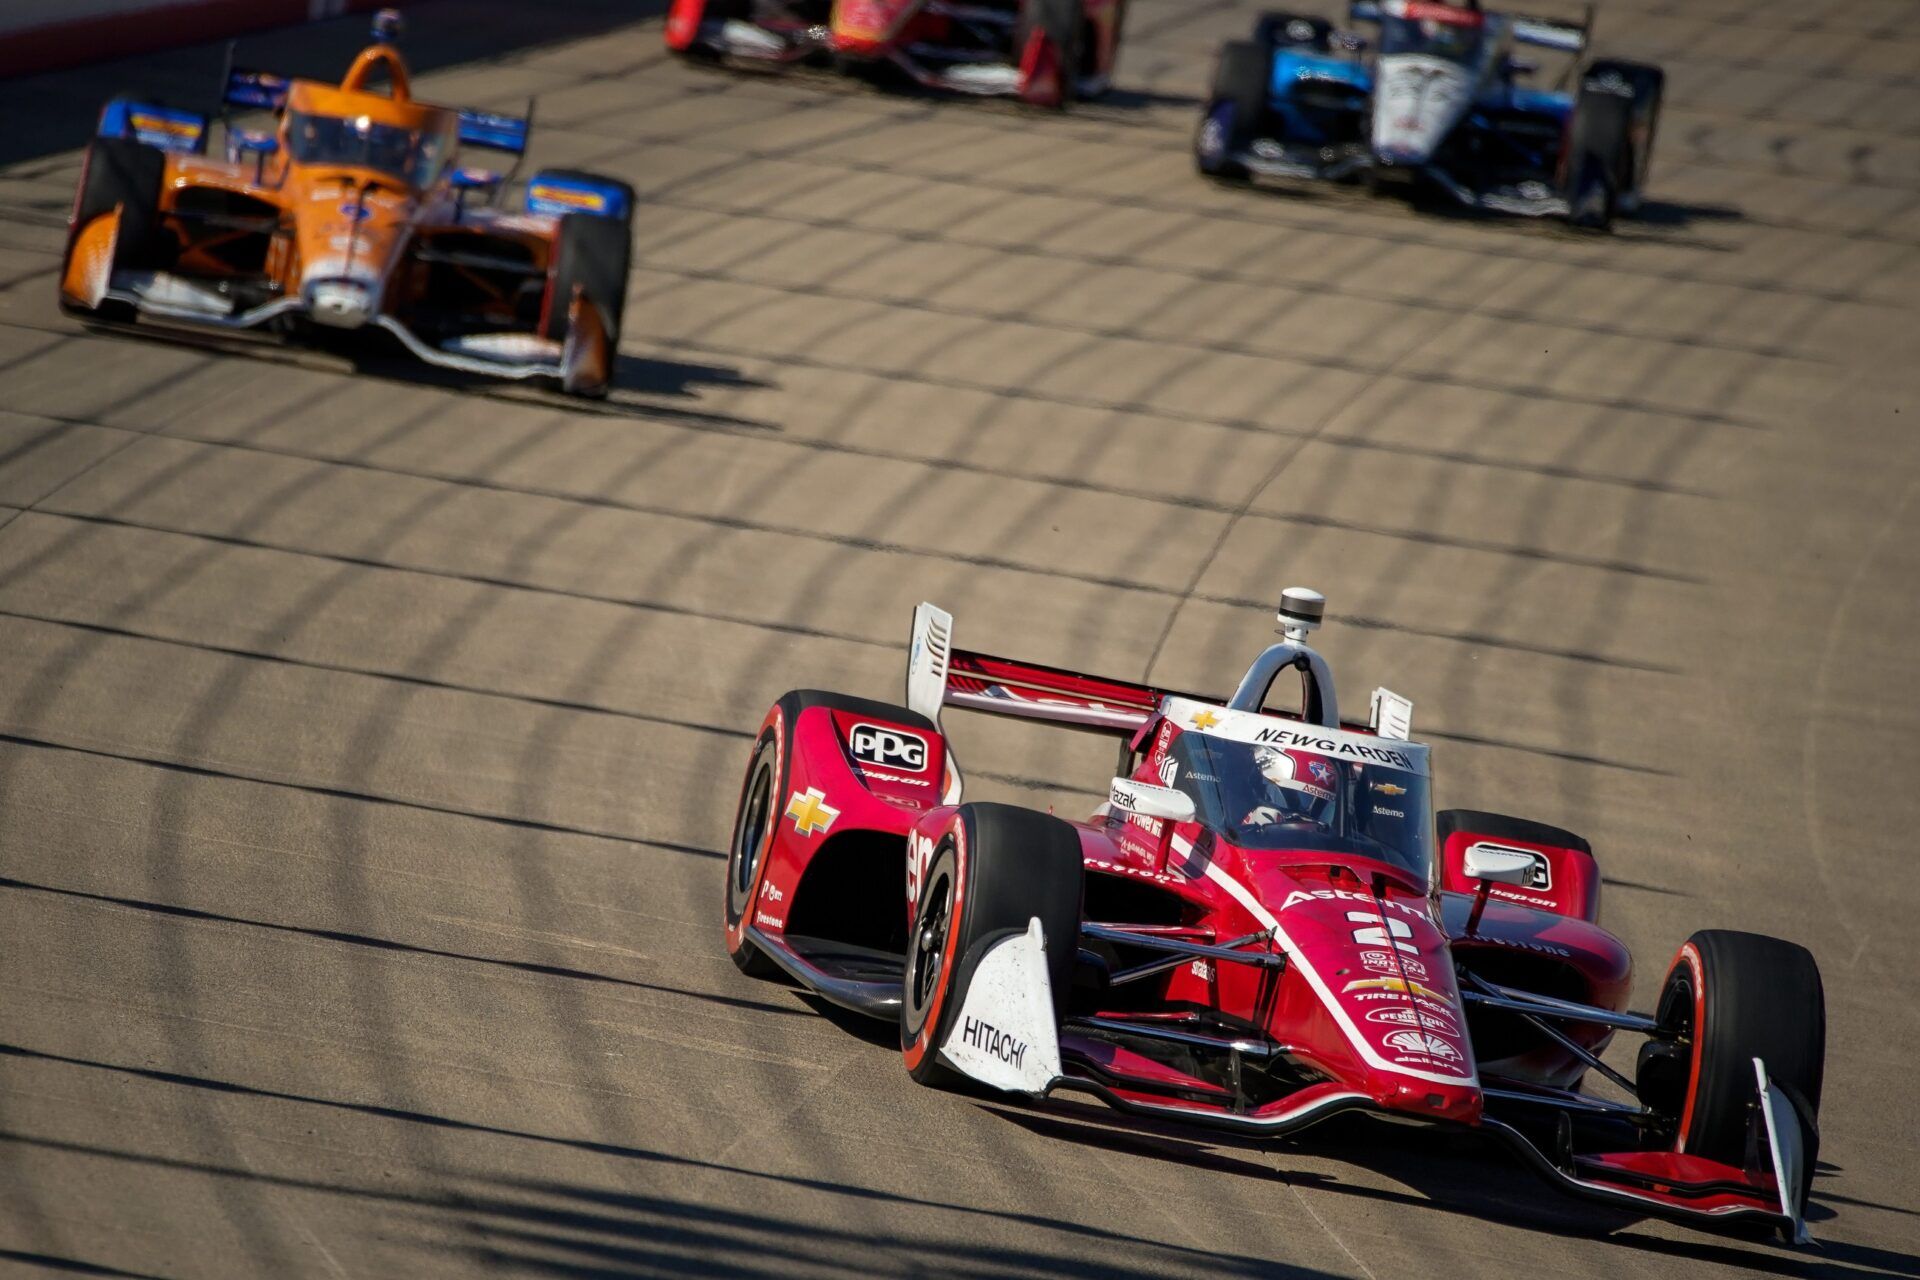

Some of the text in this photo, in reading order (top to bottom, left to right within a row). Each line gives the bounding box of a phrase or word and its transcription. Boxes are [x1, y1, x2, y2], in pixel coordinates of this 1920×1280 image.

[855, 731, 923, 765] PPG
[1255, 727, 1415, 770] NEWGARDEN
[1184, 770, 1222, 783] Astemo
[1372, 805, 1405, 818] Astemo
[1345, 911, 1420, 956] 2
[963, 1015, 1028, 1070] HITACHI
